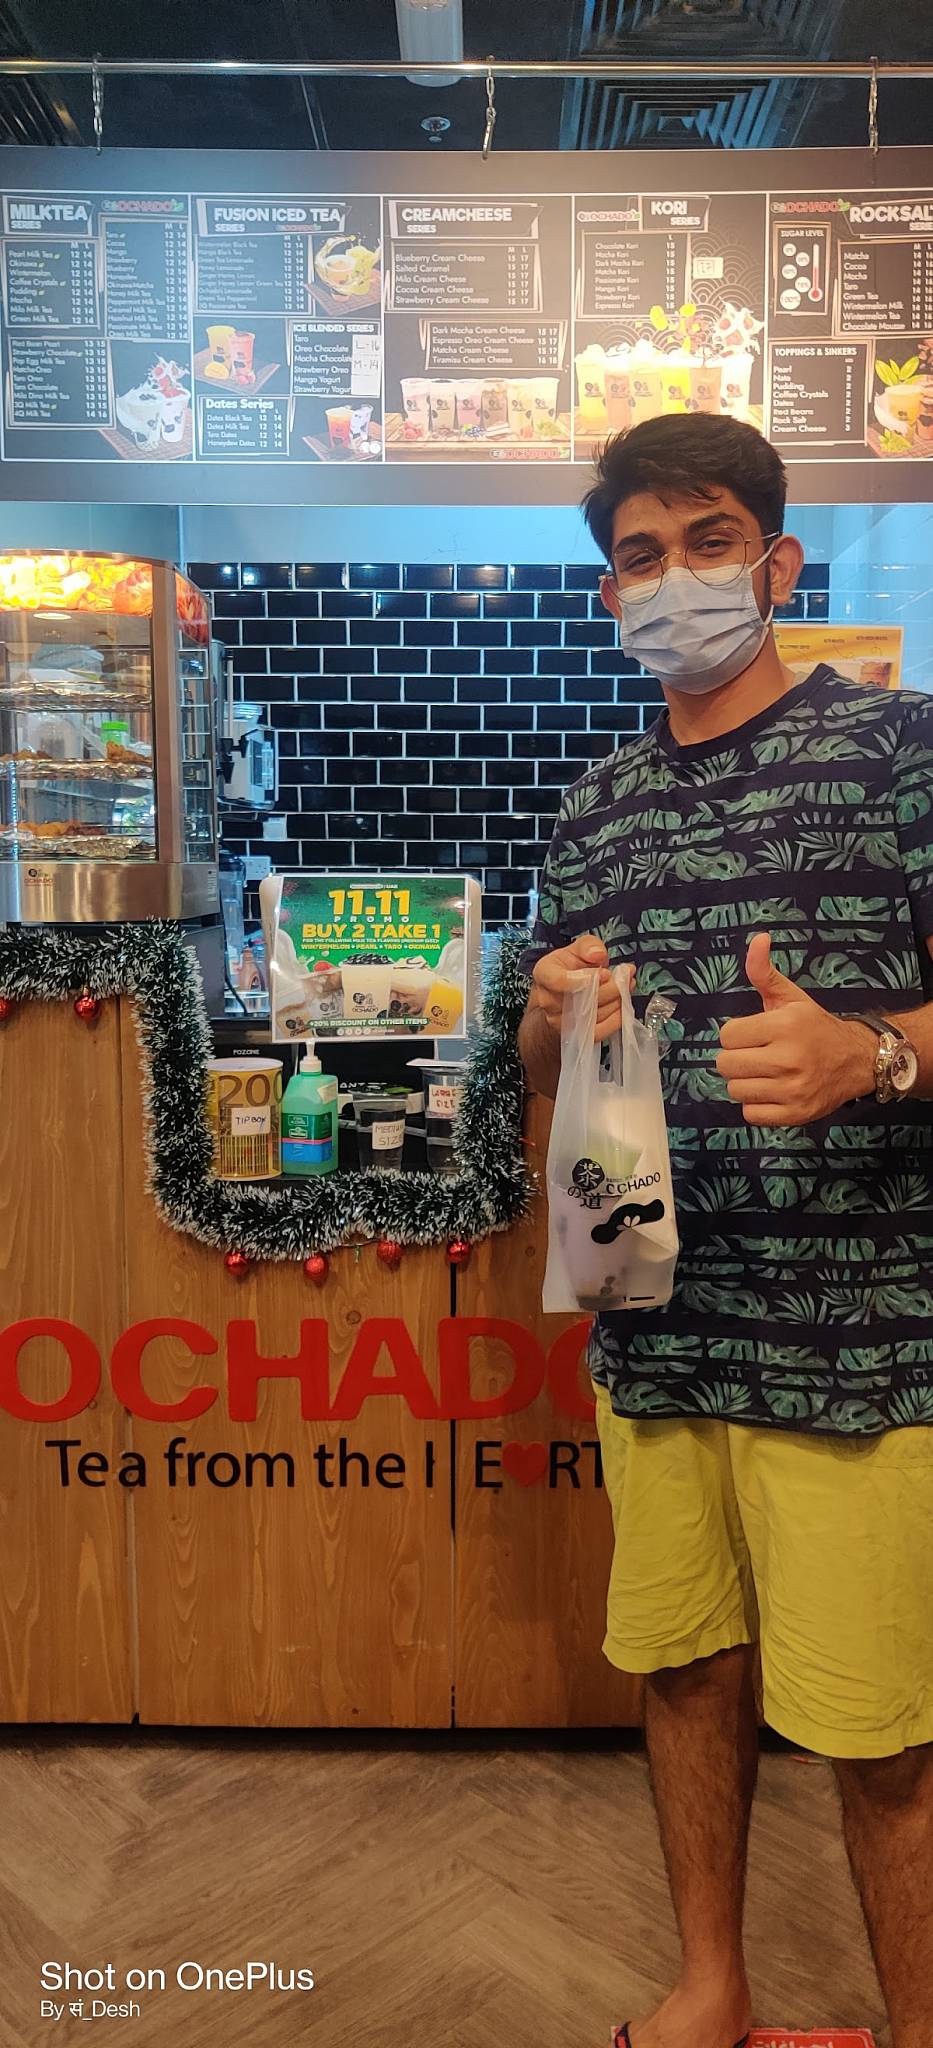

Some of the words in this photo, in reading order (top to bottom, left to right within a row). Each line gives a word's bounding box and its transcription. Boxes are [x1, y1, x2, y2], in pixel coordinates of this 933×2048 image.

[651, 201, 687, 215] KORI
[10, 204, 88, 221] MILKTEA
[214, 208, 269, 222] FUSION
[272, 208, 307, 222] ICED
[310, 208, 341, 222] TEA
[402, 208, 512, 222] CREAMCHEESE
[849, 205, 933, 223] ROCKSAL
[10, 221, 42, 229] SERIES
[670, 217, 700, 225] SERIES
[215, 224, 245, 232] SERIES
[407, 225, 437, 233] SERIES
[909, 222, 933, 231] SERIE
[395, 254, 430, 263] Blueberry
[432, 254, 456, 263] Cream
[457, 254, 485, 263] Cheese
[395, 264, 417, 272] Salted
[420, 264, 450, 272] Caramel
[396, 275, 411, 283] Milo
[413, 275, 437, 283] Cream
[439, 275, 467, 283] Cheese
[396, 286, 419, 294] Cocoa
[421, 286, 445, 294] Cream
[447, 286, 474, 294] Cheese
[396, 296, 434, 305] Strawberry
[435, 296, 460, 305] Cream
[461, 296, 489, 305] Cheese
[843, 302, 887, 310] Wintermelon
[889, 302, 904, 310] Milk
[843, 312, 888, 320] Wintermelon
[889, 312, 901, 320] Tea
[293, 324, 307, 332] ICE
[308, 324, 345, 332] BLENDED
[346, 324, 374, 332] SERIES
[842, 322, 877, 330] Chocolate
[879, 322, 905, 330] Mousse
[432, 327, 448, 335] Dark
[450, 327, 473, 335] Mocha
[475, 327, 497, 335] Cream
[499, 327, 525, 335] Cheese
[538, 327, 546, 335] 15
[550, 327, 557, 335] 17
[294, 335, 309, 343] Taro
[432, 337, 462, 345] Espresso
[464, 337, 482, 345] Oreo
[484, 337, 507, 345] Cream
[508, 337, 534, 345] Cheese
[538, 337, 546, 345] 15
[550, 337, 557, 345] 17
[294, 345, 313, 353] Oreo
[314, 345, 349, 353] Chocolate
[775, 347, 815, 357] TOPPINGS
[817, 347, 823, 357] &
[824, 347, 857, 357] SINKERS
[433, 356, 461, 364] Tiramisu
[463, 356, 486, 364] Cream
[487, 356, 512, 364] Cheese
[538, 356, 546, 364] 16
[550, 356, 557, 364] 18
[294, 367, 330, 375] Strawberry
[331, 367, 349, 375] Oreo
[773, 365, 792, 373] Pearl
[294, 376, 318, 385] Mango
[319, 376, 341, 385] Yogurt
[294, 386, 330, 394] Strawberry
[773, 383, 804, 391] Pudding
[773, 391, 798, 399] Coffee
[800, 391, 829, 399] Crystals
[205, 399, 237, 409] Dates
[240, 399, 274, 409] Series
[328, 890, 410, 915] 11.11
[302, 924, 348, 938] BUY
[351, 924, 365, 938] 2
[369, 924, 427, 938] TAKE
[432, 924, 441, 938] 1
[218, 1070, 283, 1108] 200
[44, 1439, 146, 1488] Tea
[164, 1437, 296, 1488] from
[314, 1437, 406, 1488] the
